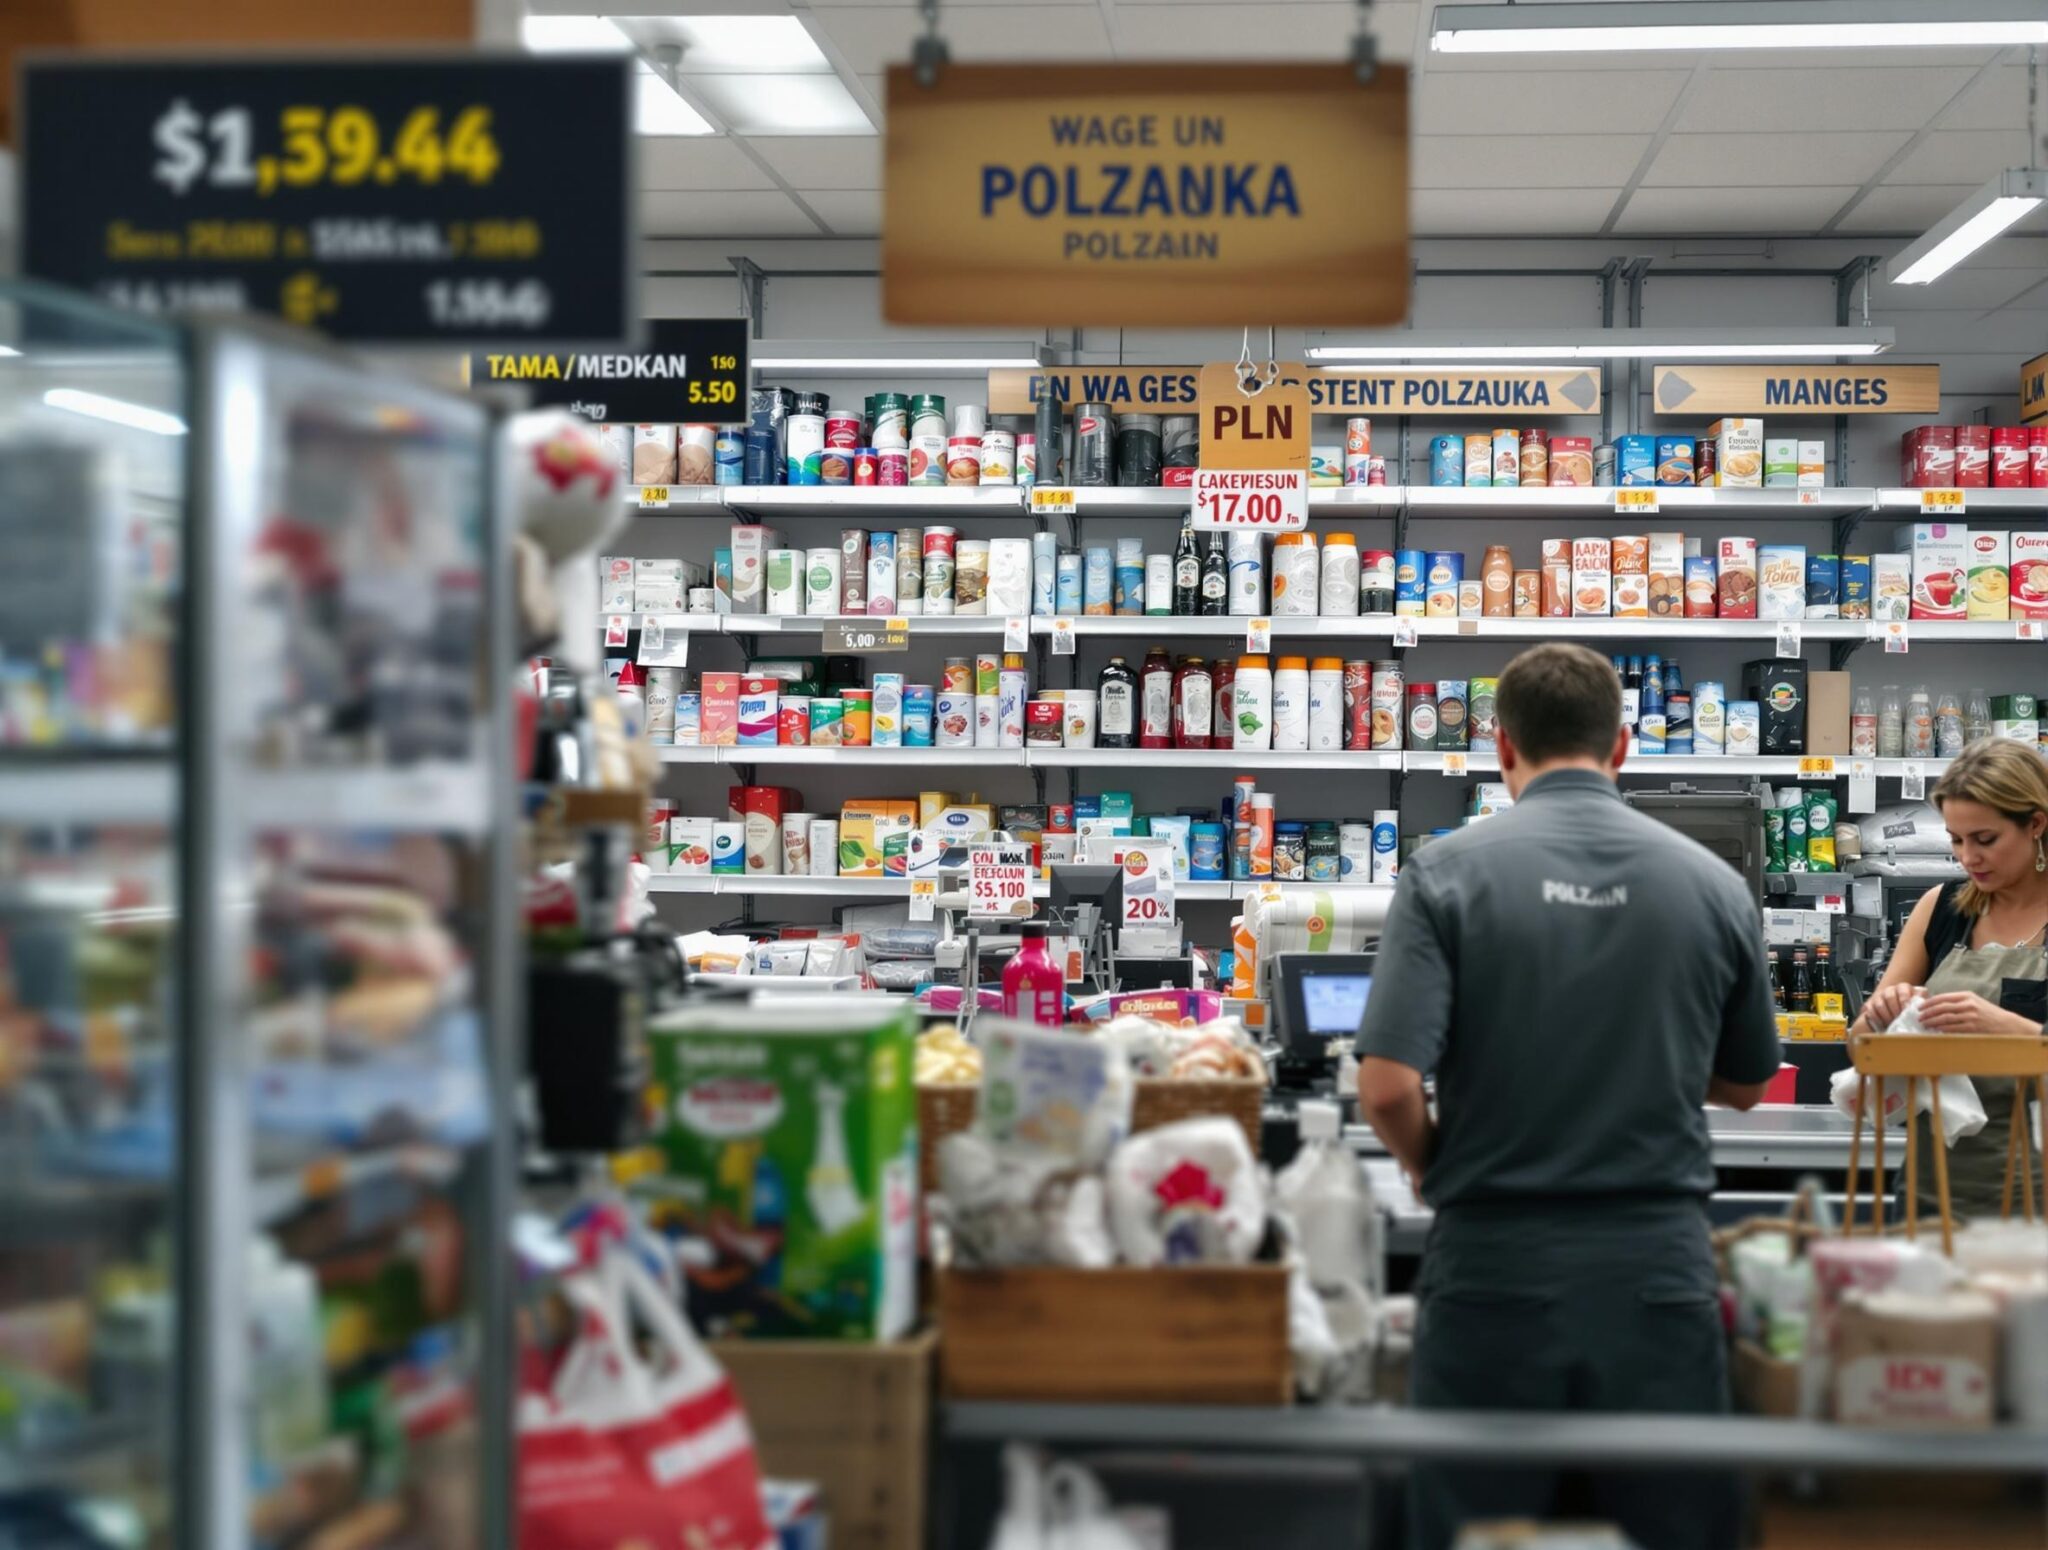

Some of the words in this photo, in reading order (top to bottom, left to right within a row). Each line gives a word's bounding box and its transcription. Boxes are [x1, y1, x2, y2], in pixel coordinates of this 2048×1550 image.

[1050, 116, 1157, 147] WAGE
[1174, 116, 1224, 147] UN
[688, 381, 736, 403] 5.50
[1404, 379, 1550, 406] POLZAUKA
[1765, 378, 1888, 405] MANGES
[1214, 405, 1292, 440] PLN
[975, 881, 1024, 898] $5.100
